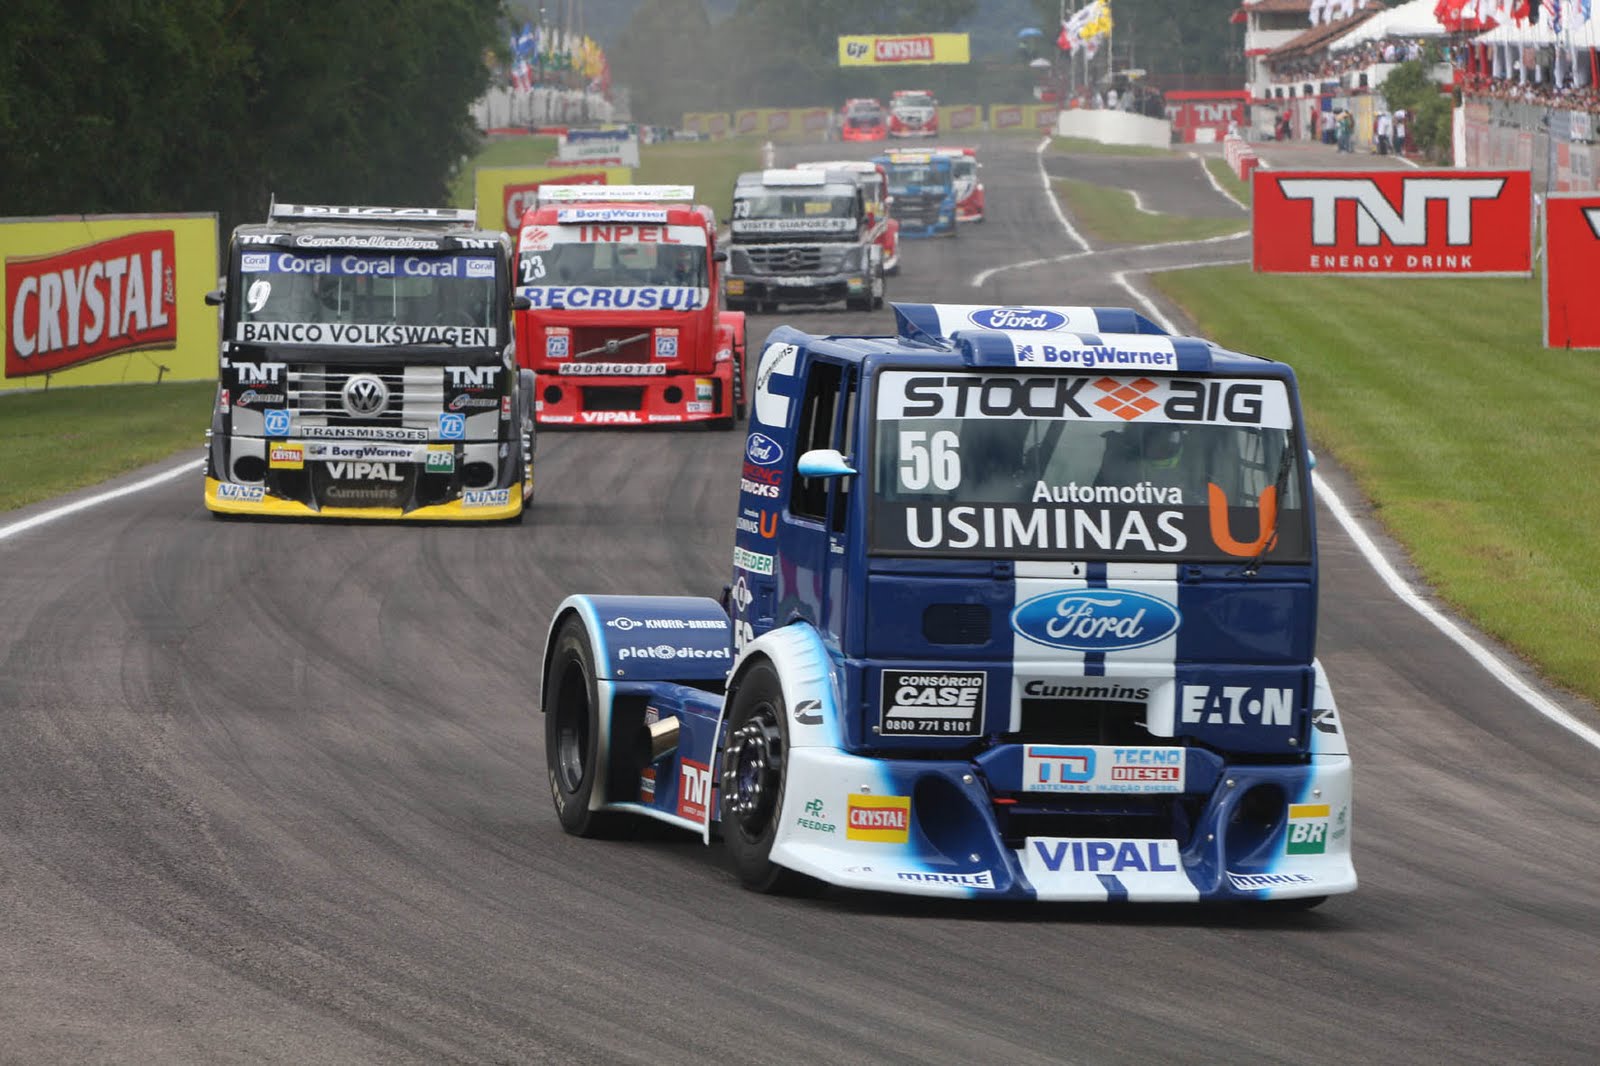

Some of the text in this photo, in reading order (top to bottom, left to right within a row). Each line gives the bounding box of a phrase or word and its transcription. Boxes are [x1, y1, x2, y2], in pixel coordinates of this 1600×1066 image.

[576, 210, 665, 220] BorgWarner
[1277, 177, 1507, 246] TNT
[240, 234, 282, 245] TNT
[296, 235, 439, 250] Constellation
[455, 237, 499, 249] TNT
[579, 226, 681, 243] INPEL
[277, 253, 457, 276] Coral Coral Coral
[520, 255, 546, 283] 23
[1310, 254, 1473, 268] ENERGY DRINK
[13, 249, 168, 358] CRYSTAL
[247, 279, 272, 313] 9
[524, 287, 703, 308] RECRUSUL
[989, 308, 1049, 330] Ford
[243, 323, 490, 346] BANCO VOLKSWAGEN
[1043, 344, 1176, 368] BorgWarner
[232, 362, 287, 381] TNT
[445, 366, 502, 385] TNT
[561, 364, 664, 374] RODRIGOTTO
[903, 377, 1092, 418] STOCK
[581, 411, 642, 423] VIPAL
[332, 446, 413, 458] BorgWarner
[750, 435, 771, 460] Ford
[428, 454, 452, 465] BR
[900, 430, 961, 490] 56
[325, 461, 405, 482] VIPAL
[325, 485, 398, 499] Cummins
[1032, 480, 1183, 505] Automotiva
[905, 482, 1278, 557] USIMINAS U
[645, 619, 728, 629] KNORR-BREMSE
[1046, 596, 1146, 639] Ford
[899, 674, 982, 687] CONSÓRCIO
[1024, 680, 1150, 700] Cummins
[895, 686, 979, 706] CASE
[1182, 685, 1293, 726] EATON
[886, 720, 971, 732] 0800 771 8101
[1113, 750, 1180, 764] TECNO
[1113, 768, 1178, 780] DIESEL
[797, 818, 836, 833] FEEDER
[850, 809, 905, 827] CRYSTAL
[1291, 823, 1325, 843] BR
[1035, 841, 1177, 872] VIPAL
